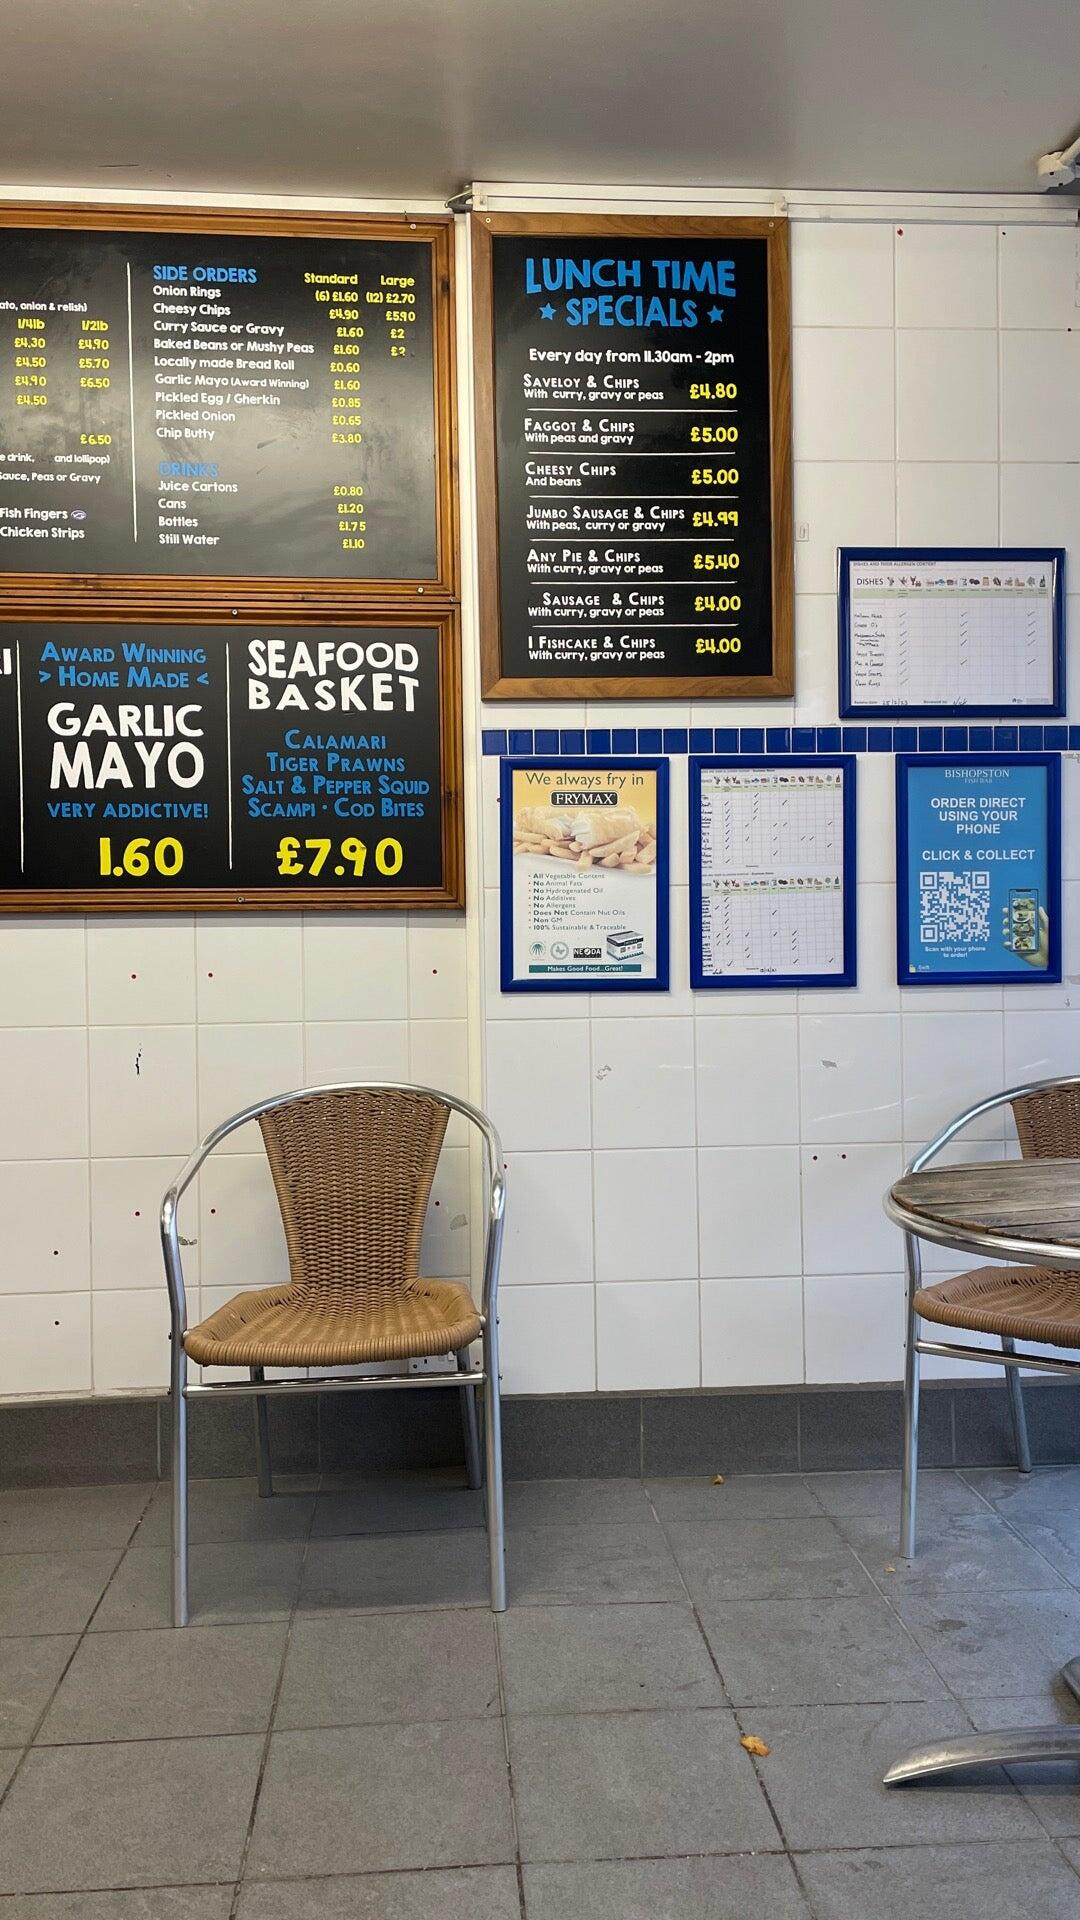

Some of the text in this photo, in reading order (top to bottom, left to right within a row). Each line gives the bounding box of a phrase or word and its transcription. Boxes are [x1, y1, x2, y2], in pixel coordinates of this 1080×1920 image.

[153, 266, 257, 283] SIDE ORDERS
[304, 273, 415, 288] Standard Large
[526, 258, 736, 297] LUNCH TIME
[153, 286, 221, 299] Onion Rings
[333, 292, 415, 303] £1.60 £2.70
[153, 303, 231, 317] Cheesy Chips
[329, 309, 359, 319] £4.90
[566, 295, 698, 327] SPECIALS
[337, 327, 404, 338] £1.60 £2
[15, 338, 109, 350] £4.30 £4.90
[334, 345, 359, 355] £1.60
[529, 348, 734, 365] Every day from 11.30am 2pm
[16, 357, 109, 369] £4.50 £5.70
[330, 363, 360, 372] £0.60
[334, 380, 360, 390] £1.60
[587, 375, 597, 388] &
[524, 389, 548, 398] With
[552, 391, 586, 400] curry,
[589, 392, 621, 401] gravy
[638, 392, 664, 401] peas
[690, 383, 737, 400] £4.80
[156, 392, 280, 405] Pickled Egg Gherkin
[332, 398, 360, 407] £0.85
[156, 410, 235, 421] Pickled Onion
[332, 416, 361, 425] £0.65
[80, 434, 111, 445] £6.50
[156, 428, 214, 440] Chip Butty
[332, 434, 361, 443] £3.80
[690, 427, 738, 442] £5.00
[159, 462, 218, 479] DRINKS
[525, 477, 581, 486] And beans
[691, 469, 739, 485] £5.00
[334, 486, 363, 496] £0.80
[0, 508, 68, 521] Fish Fingers
[338, 504, 363, 513] £1.20
[158, 516, 198, 527] Bottles
[693, 511, 739, 527] £4.99
[339, 522, 366, 531] £1.75
[0, 527, 85, 540] Chicken Strips
[159, 534, 219, 545] Still Water
[343, 539, 364, 548] £1.10
[694, 554, 739, 570] £5.40
[695, 596, 741, 611] £4.00
[696, 638, 741, 654] £4.00
[248, 639, 419, 679] SEAFOOD
[249, 673, 419, 712] BASKET
[48, 703, 204, 737] GARLIC
[50, 741, 204, 789] MAYO
[945, 769, 1010, 778] BISHOPSTON
[291, 775, 306, 795] &
[526, 773, 644, 789] We always fry in
[556, 794, 614, 804] FRYMAX
[931, 797, 1026, 808] ORDER DIRECT
[47, 802, 209, 819] VERY ADDICTIVE!
[939, 810, 1018, 821] USING YOUR
[957, 824, 1001, 834] PHONE
[100, 837, 184, 877] 1.60
[276, 836, 403, 877] £7.90
[922, 850, 1035, 861] CLICK & COLLECT
